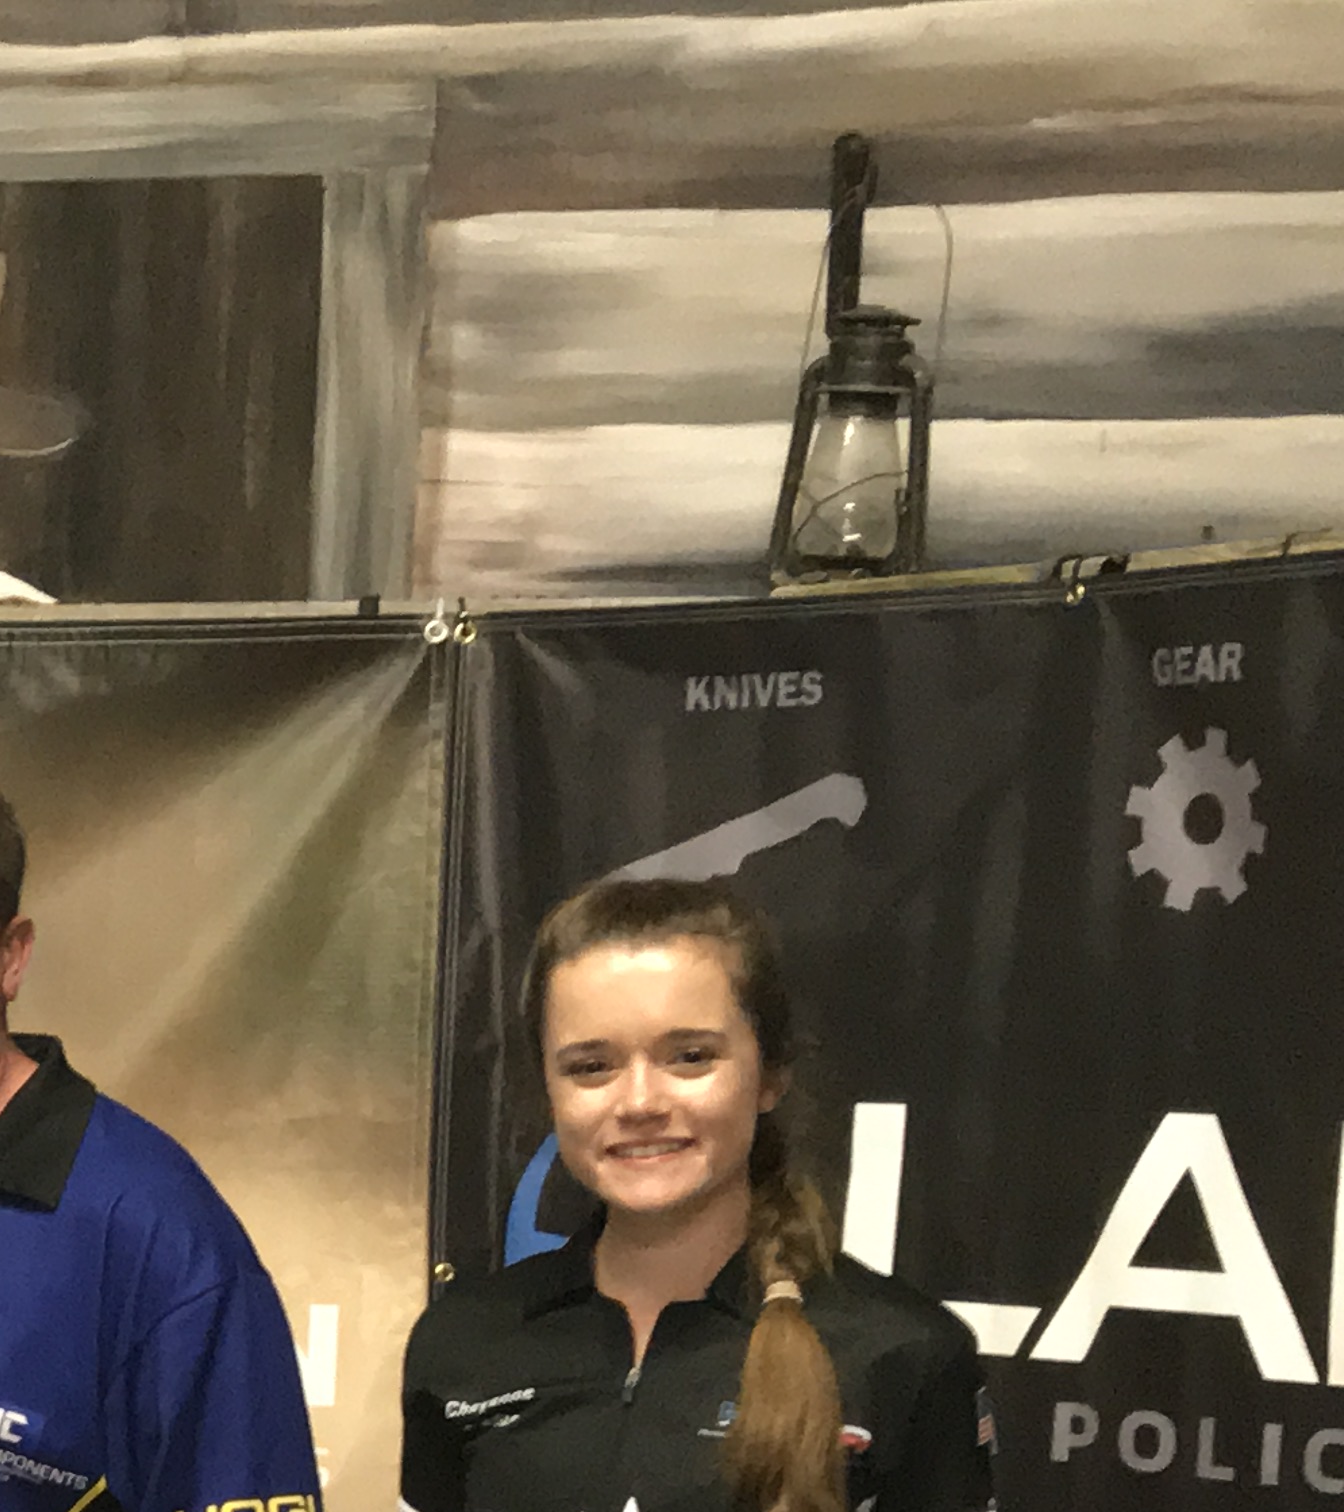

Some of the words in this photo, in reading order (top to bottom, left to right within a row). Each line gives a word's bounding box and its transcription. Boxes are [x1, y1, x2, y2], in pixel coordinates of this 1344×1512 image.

[1152, 641, 1245, 686] GEAR
[685, 670, 824, 712] KNIVES
[840, 1101, 1344, 1387] LA
